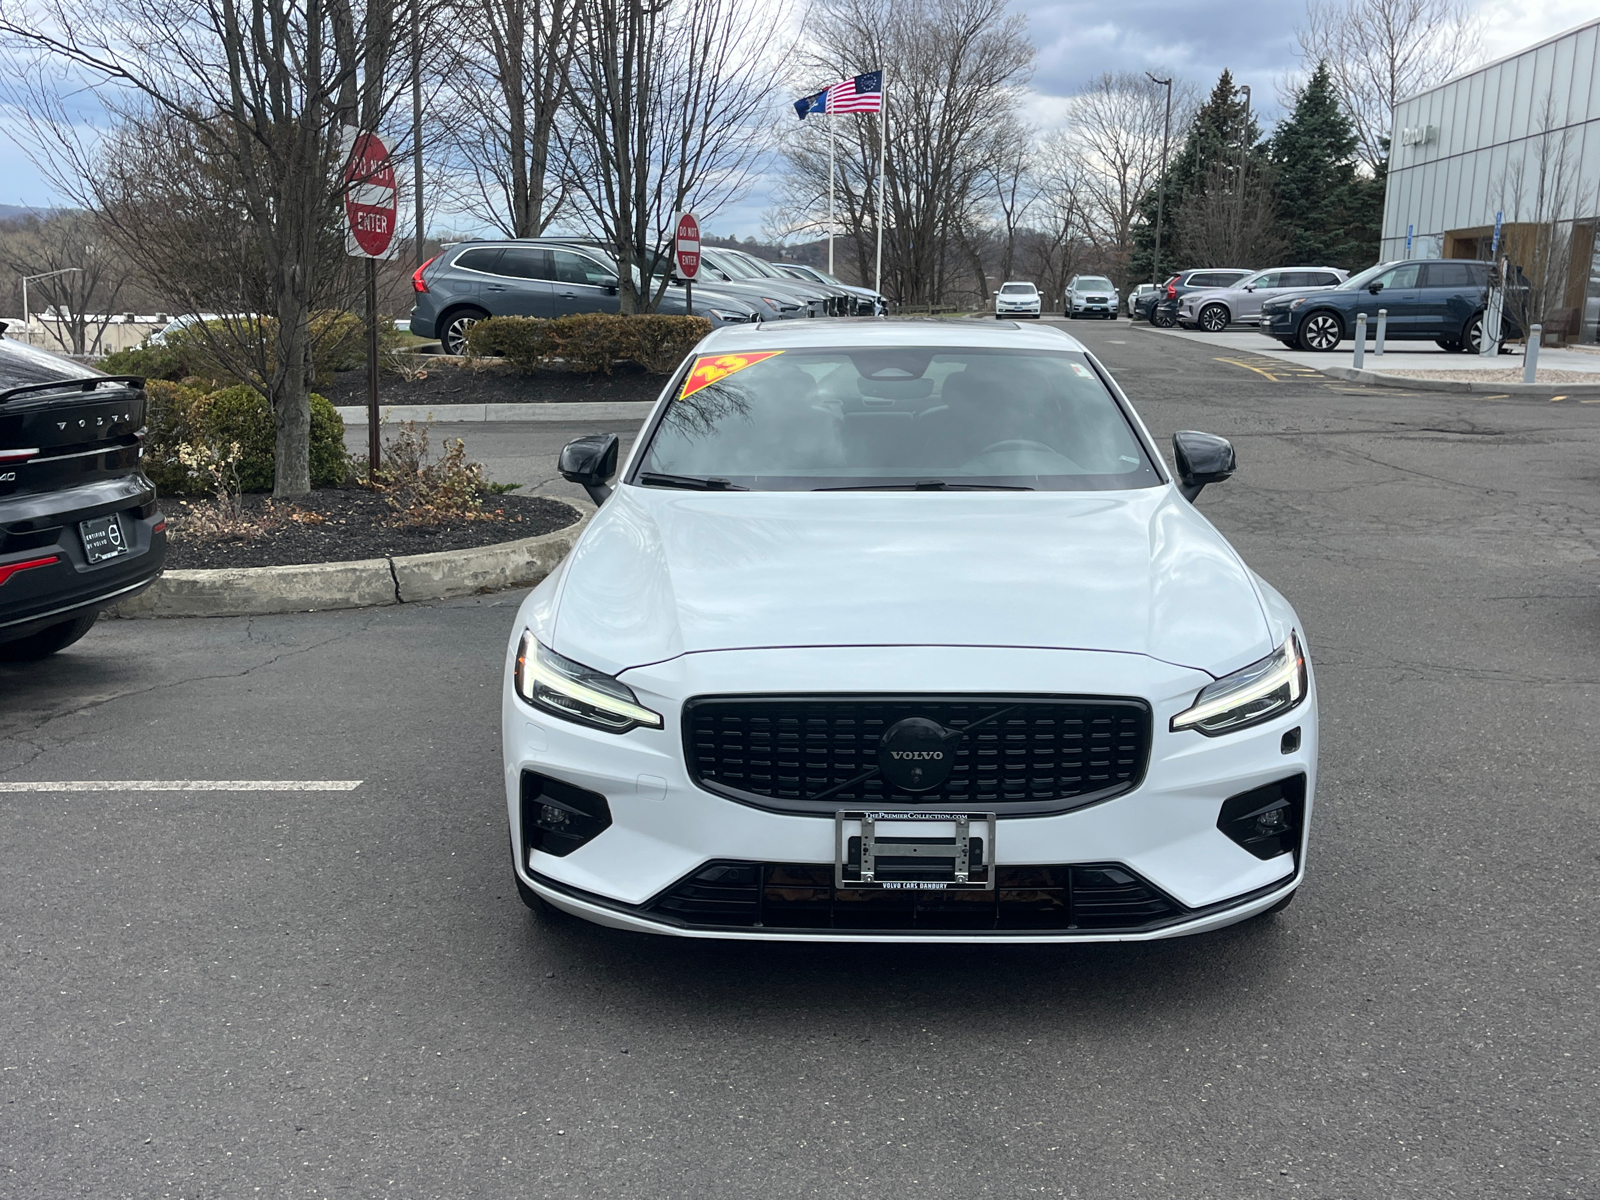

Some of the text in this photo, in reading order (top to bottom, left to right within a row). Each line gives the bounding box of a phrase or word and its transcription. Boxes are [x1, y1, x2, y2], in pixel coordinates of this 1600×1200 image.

[353, 156, 390, 180] DO NOT
[357, 211, 387, 233] ENTER
[679, 226, 698, 238] DO NOT
[682, 255, 697, 266] ENTER
[694, 355, 748, 382] 23
[57, 413, 130, 430] VOLVO
[0, 472, 16, 481] 40
[890, 751, 944, 760] VOLVO
